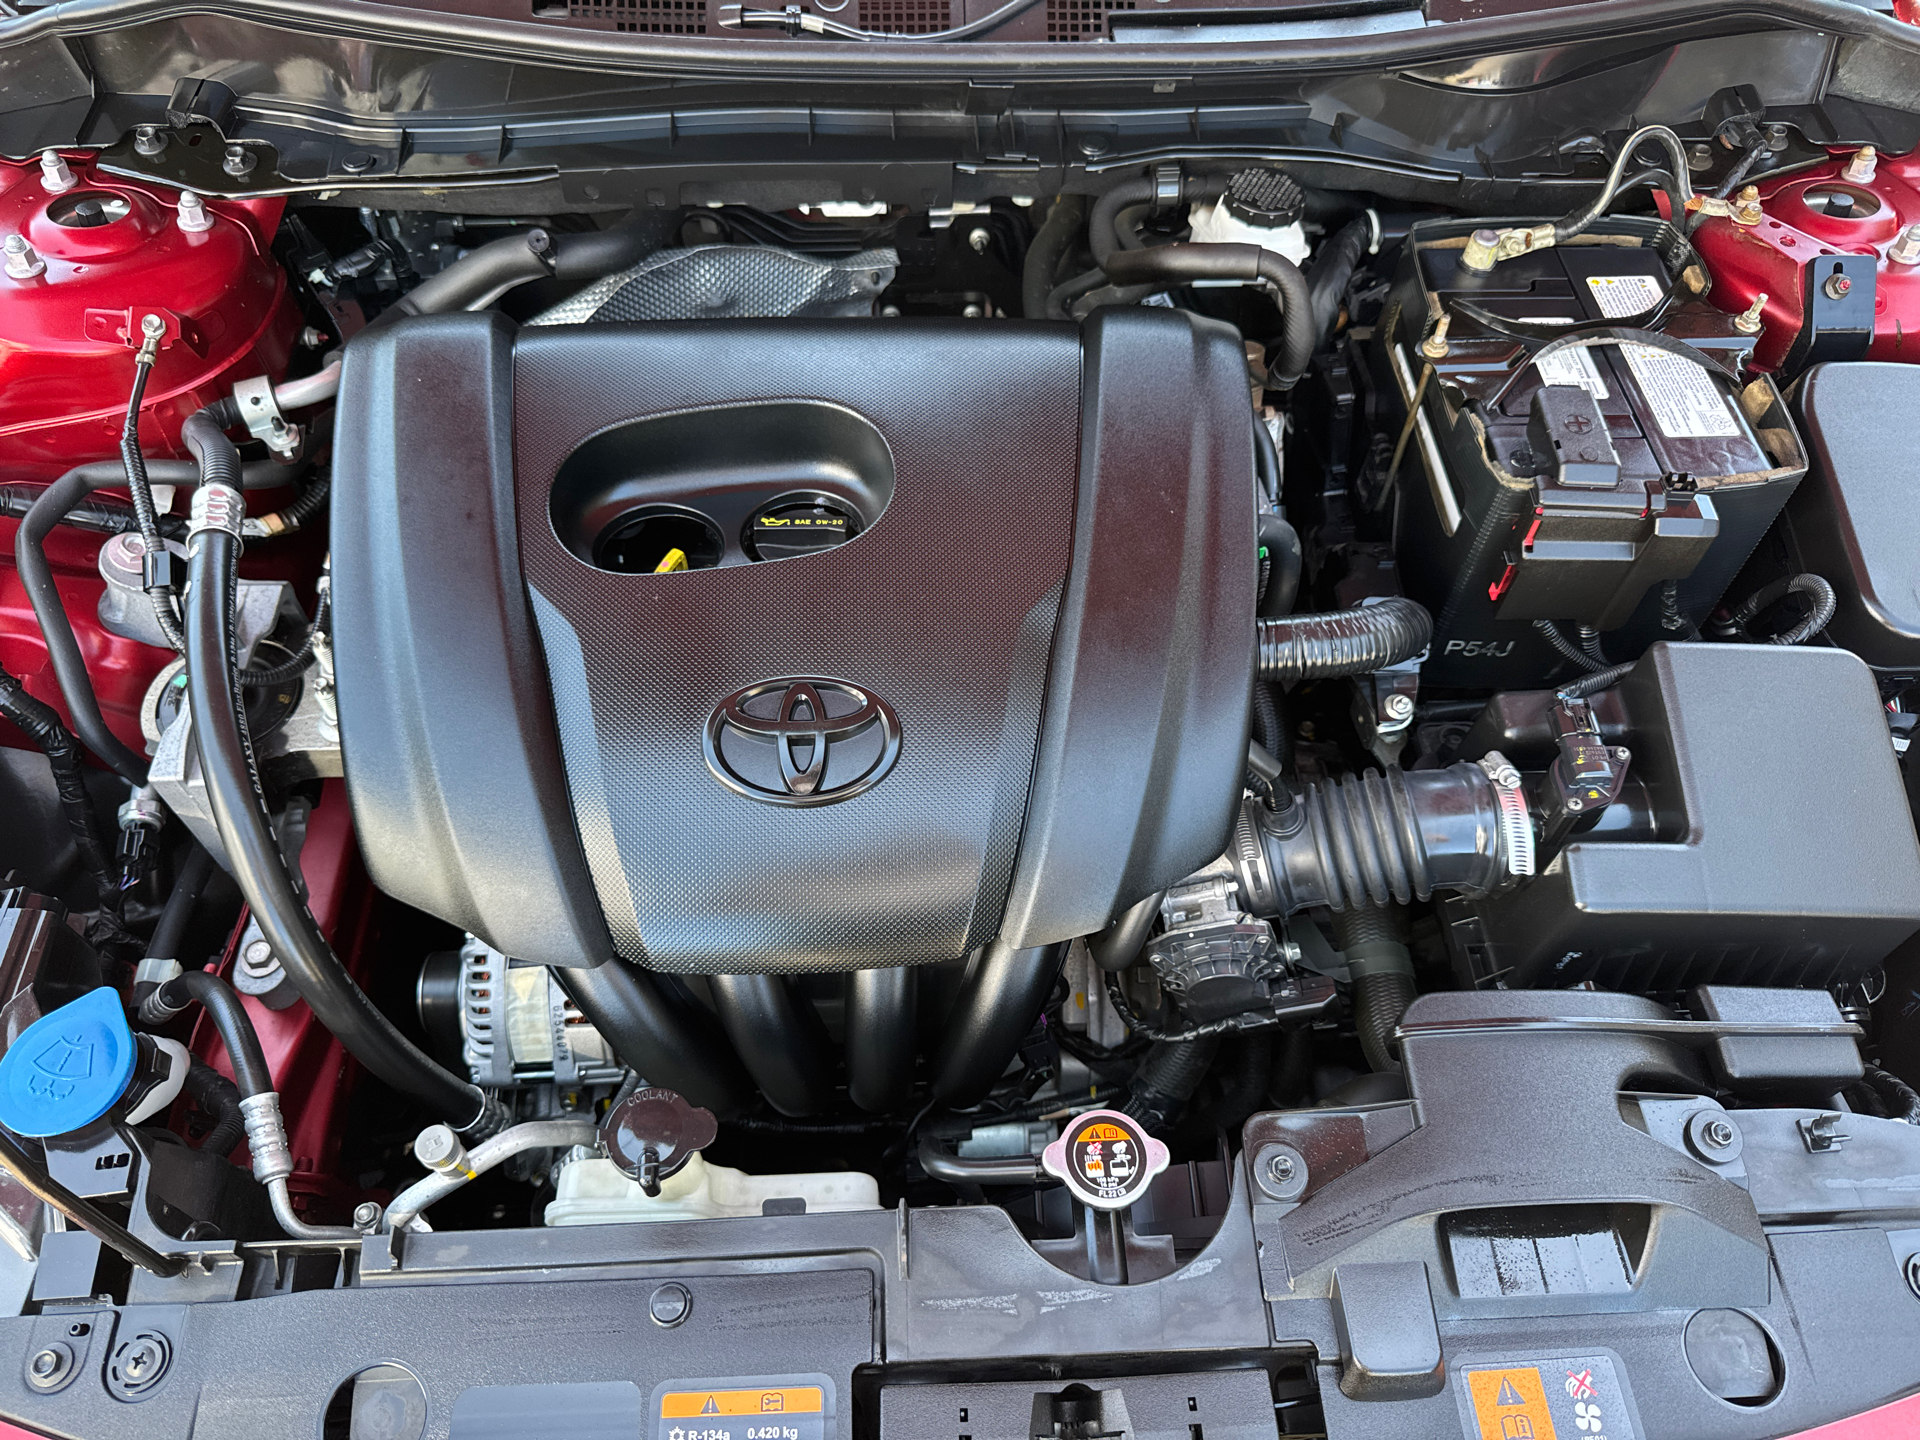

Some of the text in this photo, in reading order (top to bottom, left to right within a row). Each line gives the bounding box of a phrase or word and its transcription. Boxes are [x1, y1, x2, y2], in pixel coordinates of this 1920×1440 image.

[1444, 640, 1514, 656] P54J
[242, 737, 263, 794] GALAXY
[627, 1090, 678, 1106] COOLANT
[1098, 1189, 1117, 1198] FL22
[688, 1426, 798, 1440] R-134a 0.420 kg
